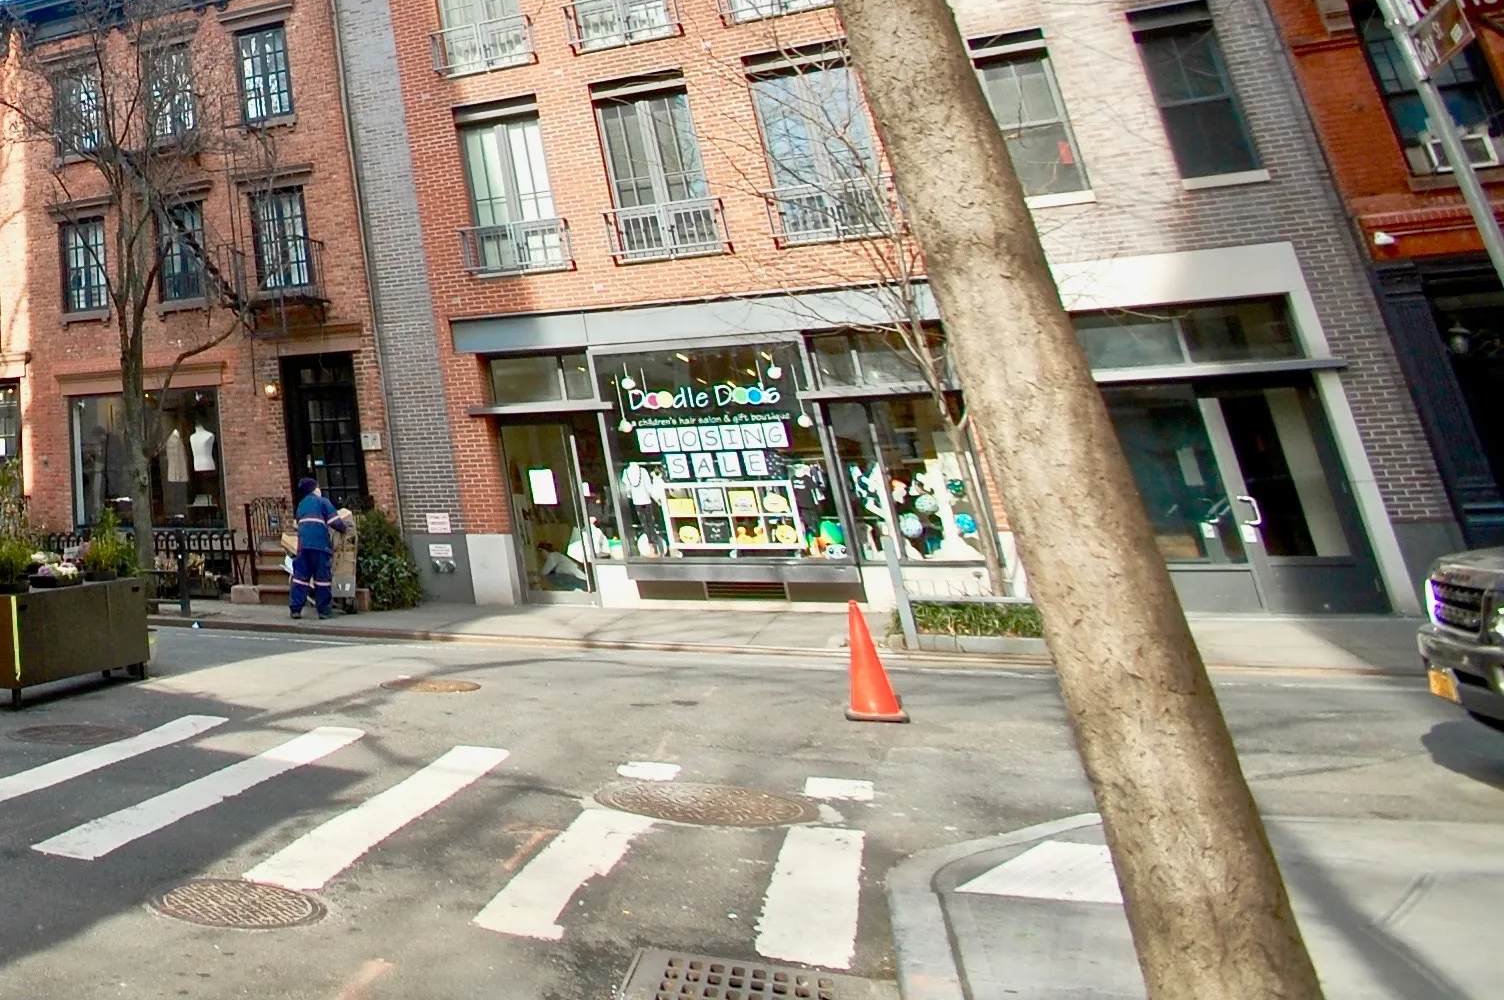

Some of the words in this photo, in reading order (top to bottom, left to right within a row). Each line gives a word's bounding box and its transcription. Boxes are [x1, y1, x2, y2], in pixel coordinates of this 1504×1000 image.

[628, 386, 709, 411] Doodle
[638, 416, 677, 427] children's
[678, 416, 696, 425] hair
[698, 415, 722, 424] salon
[723, 413, 731, 423] &
[732, 412, 749, 424] gift
[750, 411, 791, 422] boutique
[642, 426, 783, 449] CLOSING
[672, 454, 761, 474] SALE
